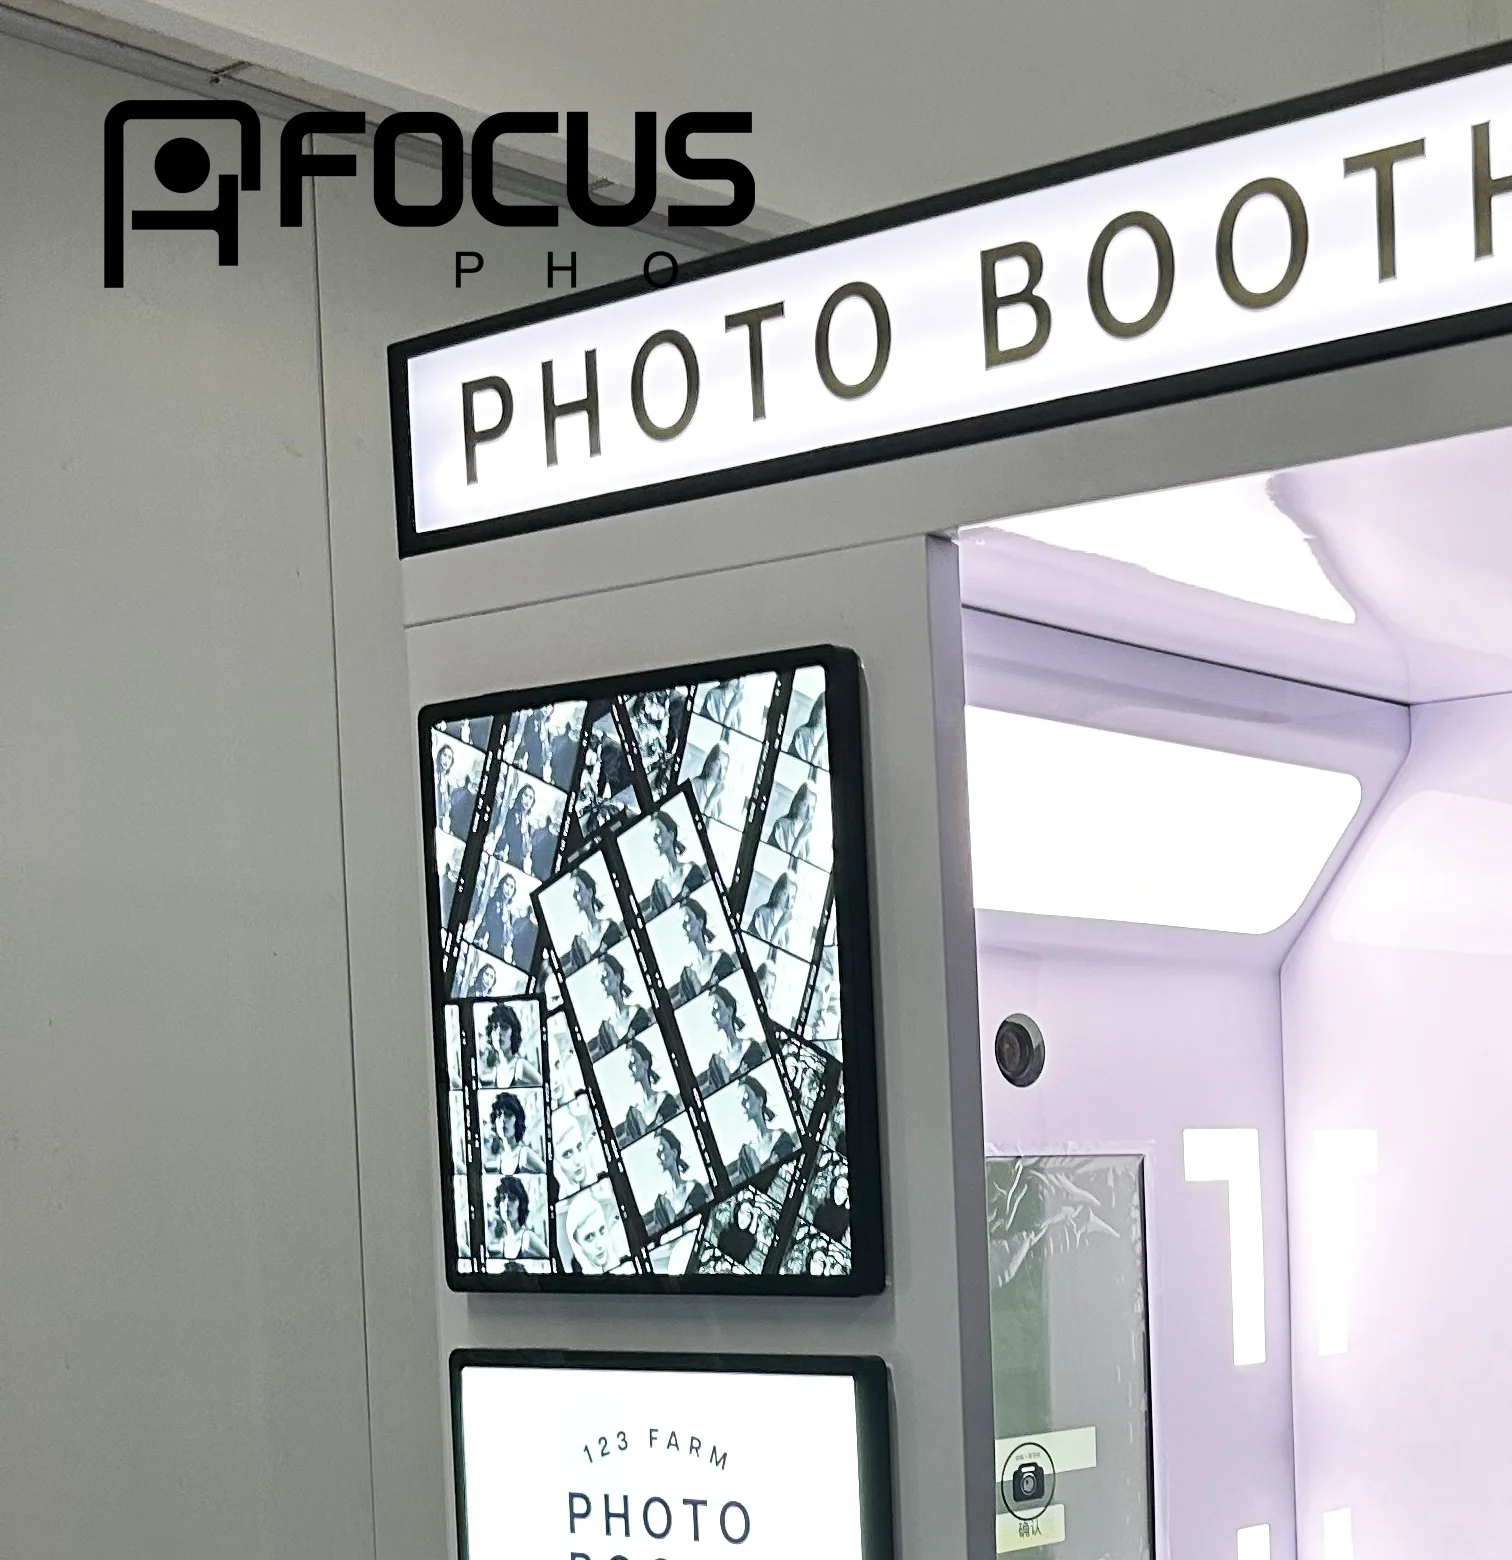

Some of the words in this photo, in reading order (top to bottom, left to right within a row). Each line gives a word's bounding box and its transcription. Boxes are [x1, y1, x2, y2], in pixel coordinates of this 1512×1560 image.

[461, 281, 893, 487] PHOTO
[583, 1431, 630, 1464] 123
[649, 1427, 729, 1470] FARM
[568, 1491, 751, 1545] PHOTO
